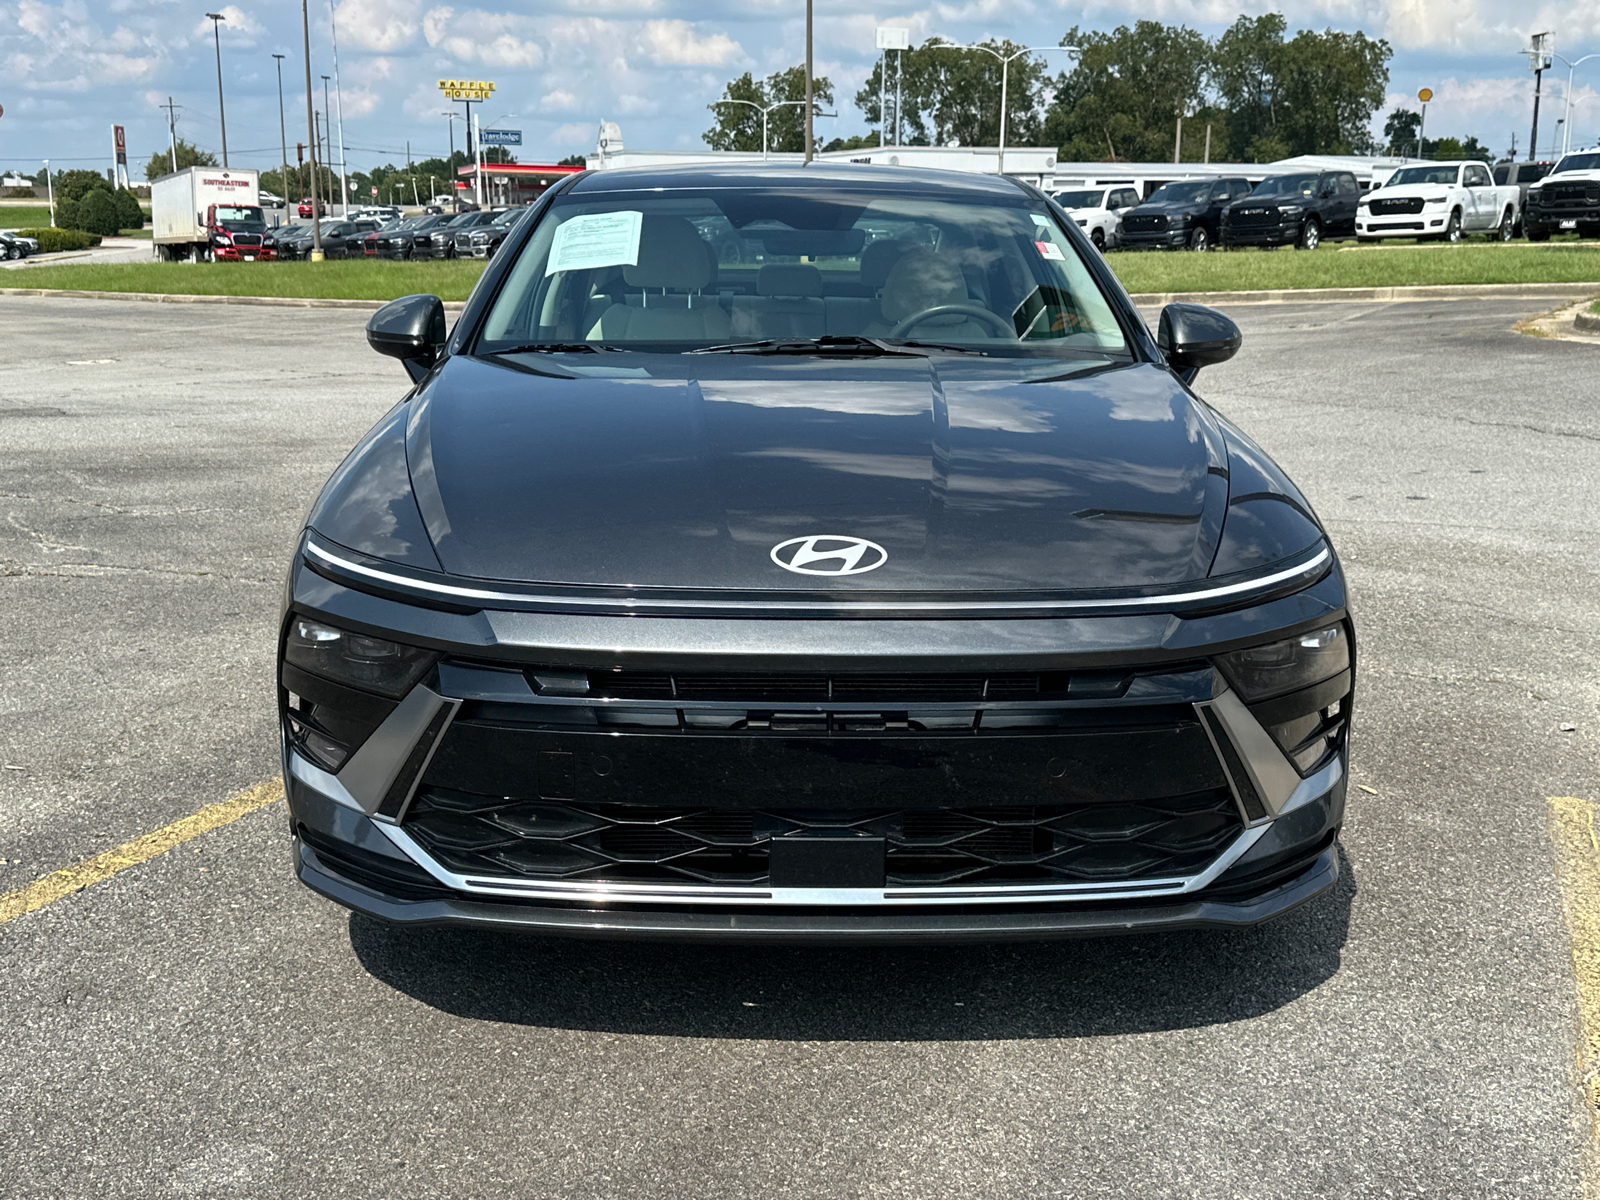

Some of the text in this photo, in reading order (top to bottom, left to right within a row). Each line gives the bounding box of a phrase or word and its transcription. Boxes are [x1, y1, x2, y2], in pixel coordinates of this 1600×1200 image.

[439, 80, 495, 90] WAFFLE
[445, 90, 491, 99] HOUSE
[203, 179, 250, 187] SOUTHEASTERN
